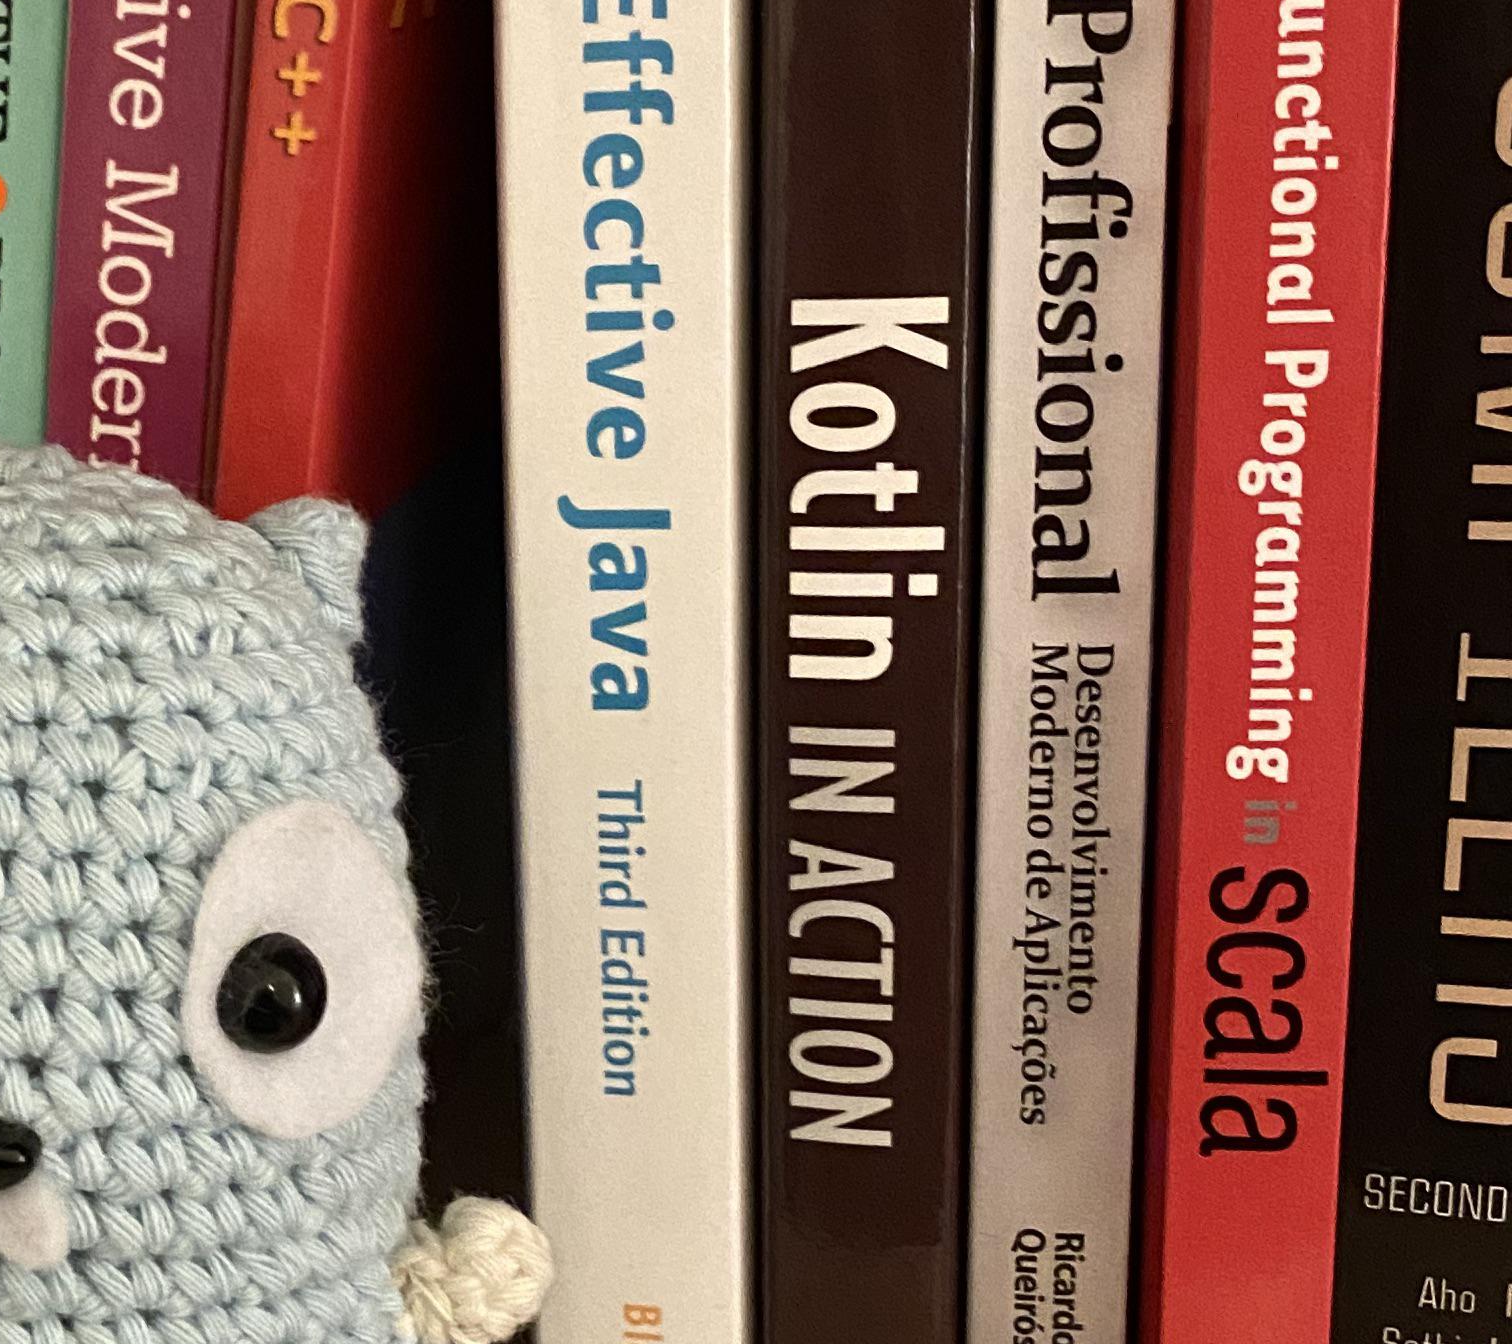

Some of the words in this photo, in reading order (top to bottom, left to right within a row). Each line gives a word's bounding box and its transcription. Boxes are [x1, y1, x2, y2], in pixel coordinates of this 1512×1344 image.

[90, 159, 179, 471] Moder
[789, 296, 949, 681] Kotlin
[1226, 350, 1329, 783] Programming
[556, 494, 672, 712] Java
[789, 726, 895, 814] IN
[1028, 641, 1069, 839] Moderno
[1067, 643, 1115, 1016] Desenvolvimento
[1243, 799, 1297, 844] in
[596, 779, 648, 911] Third
[1025, 848, 1065, 900] de
[600, 928, 650, 1097] Edition
[788, 839, 894, 1147] ACTION
[1012, 907, 1063, 1126] Aplicações
[1364, 1173, 1508, 1222] SECOND
[1418, 1276, 1475, 1313] Aho
